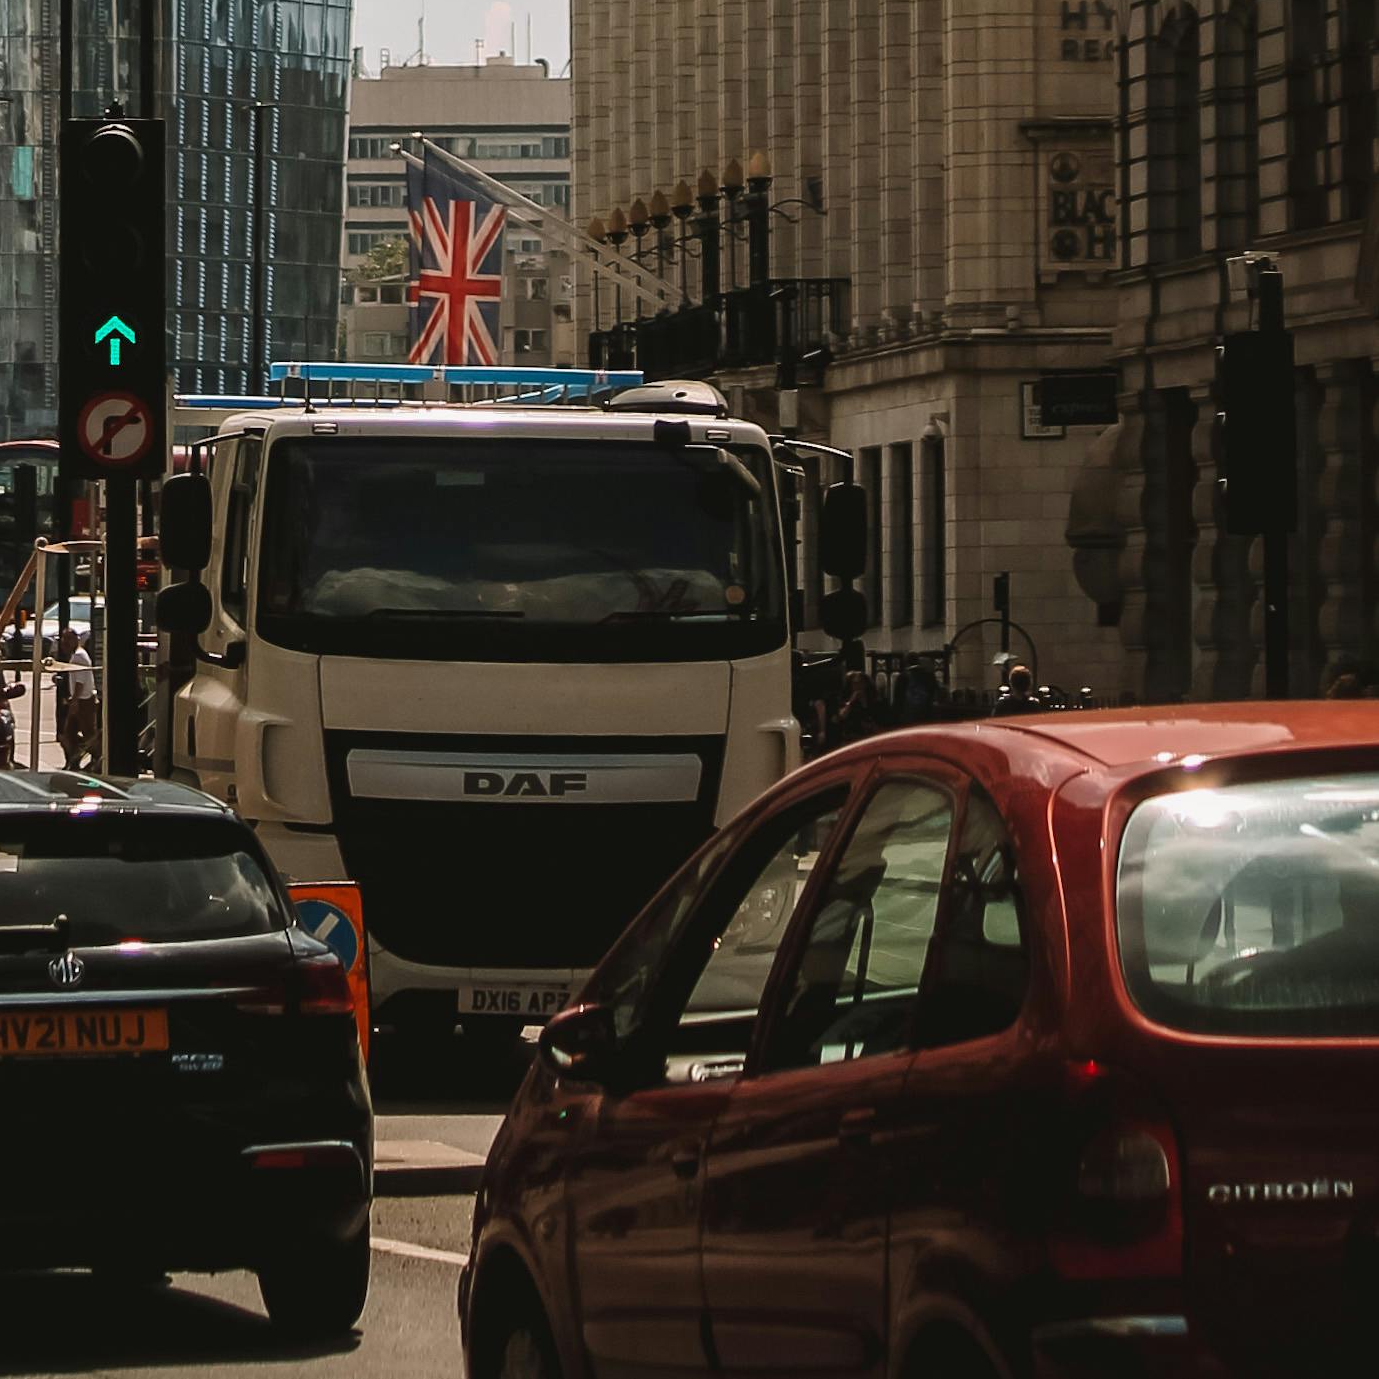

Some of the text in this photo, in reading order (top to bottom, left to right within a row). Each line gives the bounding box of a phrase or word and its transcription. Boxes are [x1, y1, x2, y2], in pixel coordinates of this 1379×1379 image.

[1085, 225, 1117, 260] H
[462, 771, 588, 798] DAF
[471, 988, 521, 1012] DX16
[76, 1014, 146, 1048] NUJ
[1208, 1177, 1354, 1203] CITROËN
